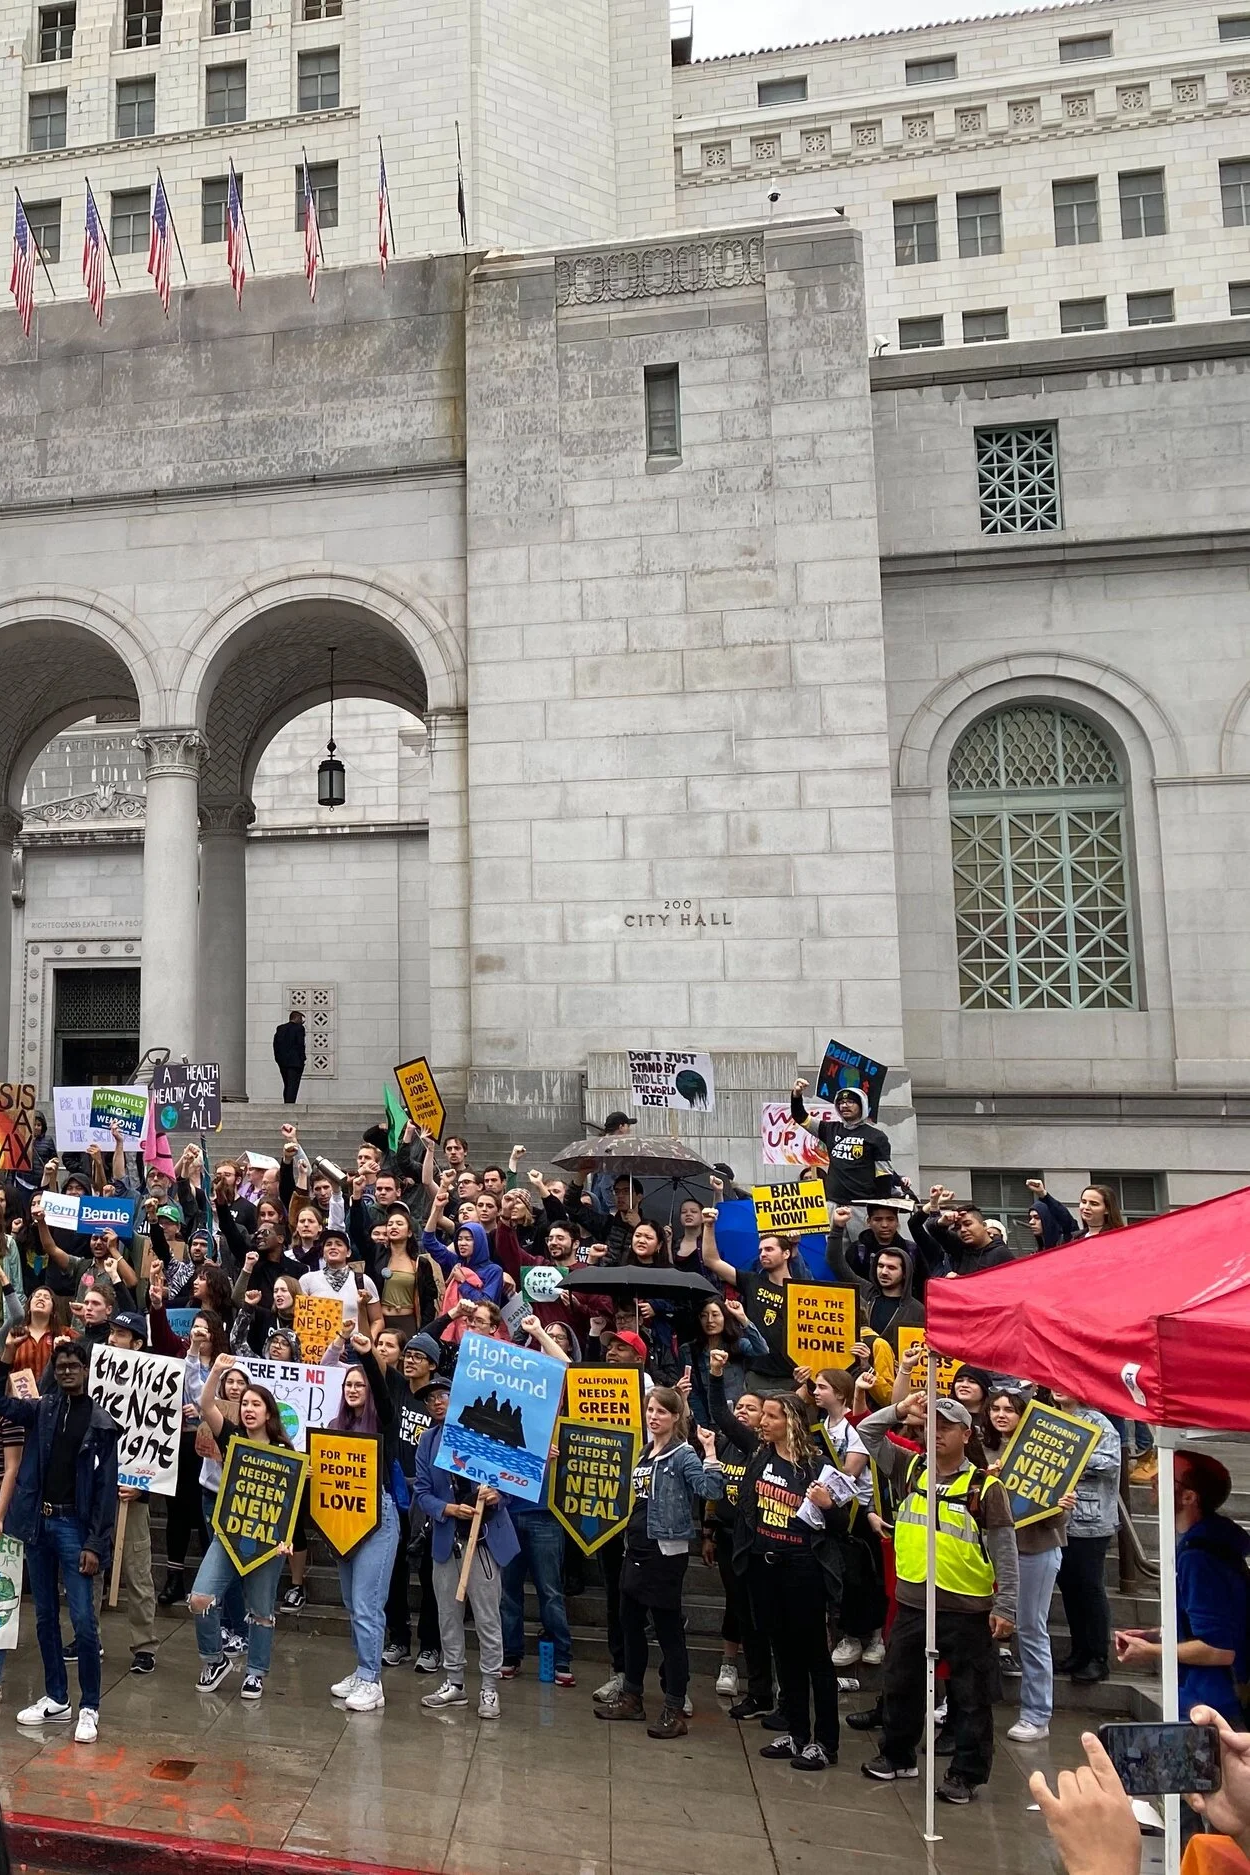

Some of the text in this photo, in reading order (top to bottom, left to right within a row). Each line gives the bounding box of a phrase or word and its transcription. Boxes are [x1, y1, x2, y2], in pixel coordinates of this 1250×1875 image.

[664, 900, 692, 910] 200
[624, 912, 732, 927] CITY HALL
[628, 1051, 697, 1065] DON'T JUST
[163, 1064, 219, 1084] A HEALTH
[630, 1062, 676, 1074] STAND BY
[404, 1072, 424, 1086] GOOD
[632, 1074, 670, 1085] AND LET
[16, 1084, 36, 1110] IS
[188, 1082, 216, 1098] CARE
[410, 1082, 428, 1096] JOBS
[633, 1085, 676, 1096] THE WORLD
[96, 1093, 144, 1108] WINDMILLS
[642, 1094, 668, 1107] DIE!
[110, 1106, 128, 1116] NOT
[418, 1109, 438, 1120] FUTURE
[12, 1109, 32, 1134] A
[190, 1110, 216, 1130] ALL
[770, 1182, 800, 1198] BAN
[754, 1195, 824, 1214] FRACKING
[82, 1206, 130, 1224] Bernie
[770, 1211, 808, 1226] NOW!
[298, 1300, 314, 1312] WE
[797, 1298, 844, 1310] FOR THE
[297, 1317, 332, 1332] NEED
[797, 1310, 844, 1323] PLACES
[797, 1324, 844, 1336] WE CALL
[797, 1338, 845, 1353] HOME
[468, 1338, 539, 1372] Higher
[94, 1350, 130, 1386] the
[280, 1366, 300, 1382] IS
[306, 1369, 326, 1385] NO
[466, 1360, 548, 1400] Ground
[578, 1377, 628, 1386] CALIFORNIA
[578, 1388, 629, 1398] NEEDS A
[126, 1389, 178, 1436] Not
[308, 1386, 325, 1422] B
[579, 1402, 630, 1414] GREEN
[1036, 1418, 1081, 1442] CALIFORNIA
[570, 1433, 623, 1448] CALIFORNIA
[1030, 1428, 1075, 1455] NEEDS A
[320, 1450, 367, 1464] FOR THE
[568, 1444, 622, 1462] NEEDS A
[1023, 1442, 1070, 1470] GREEN
[135, 1468, 156, 1476] 2020
[242, 1454, 290, 1474] CALIFORNIA
[320, 1463, 367, 1478] PEOPLE
[566, 1459, 621, 1478] GREEN
[1013, 1454, 1064, 1488] NEW
[118, 1471, 152, 1492] ang
[238, 1466, 288, 1488] NEEDS A
[334, 1480, 350, 1490] WE
[500, 1471, 529, 1488] 2020
[235, 1480, 286, 1504] GREEN
[566, 1474, 620, 1500] NEW
[1004, 1473, 1050, 1508] DEAL
[230, 1494, 282, 1525] NEW
[320, 1492, 366, 1513] LOVE
[564, 1495, 620, 1521] DEAL
[757, 1496, 797, 1518] NOTHING
[226, 1516, 278, 1546] DEAL
